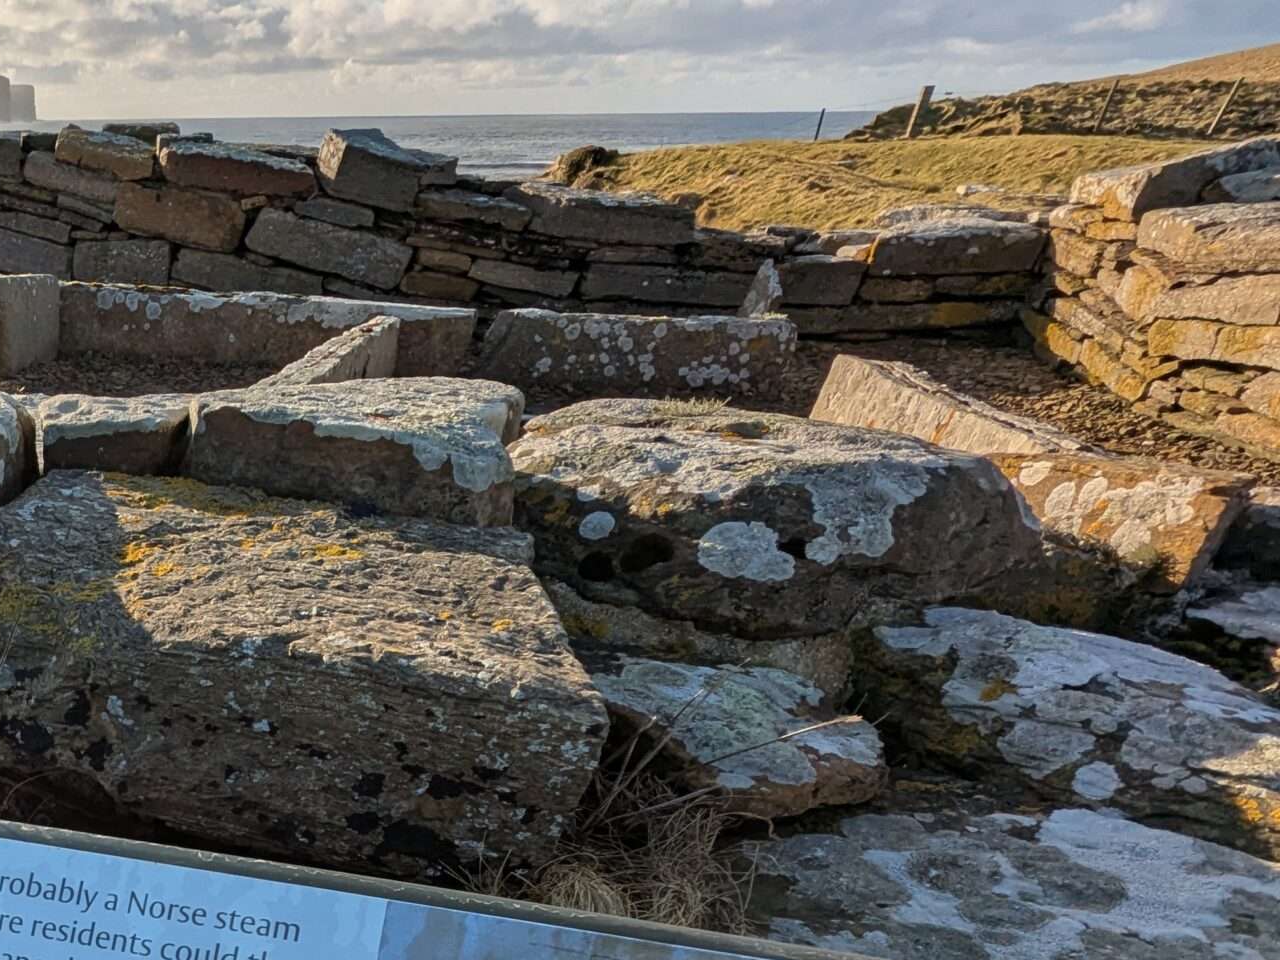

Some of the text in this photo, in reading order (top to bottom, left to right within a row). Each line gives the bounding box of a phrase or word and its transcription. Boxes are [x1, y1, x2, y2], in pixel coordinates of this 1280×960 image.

[30, 920, 153, 957] residents
[104, 893, 119, 912] a
[127, 891, 208, 927] Norse
[213, 910, 301, 943] steam
